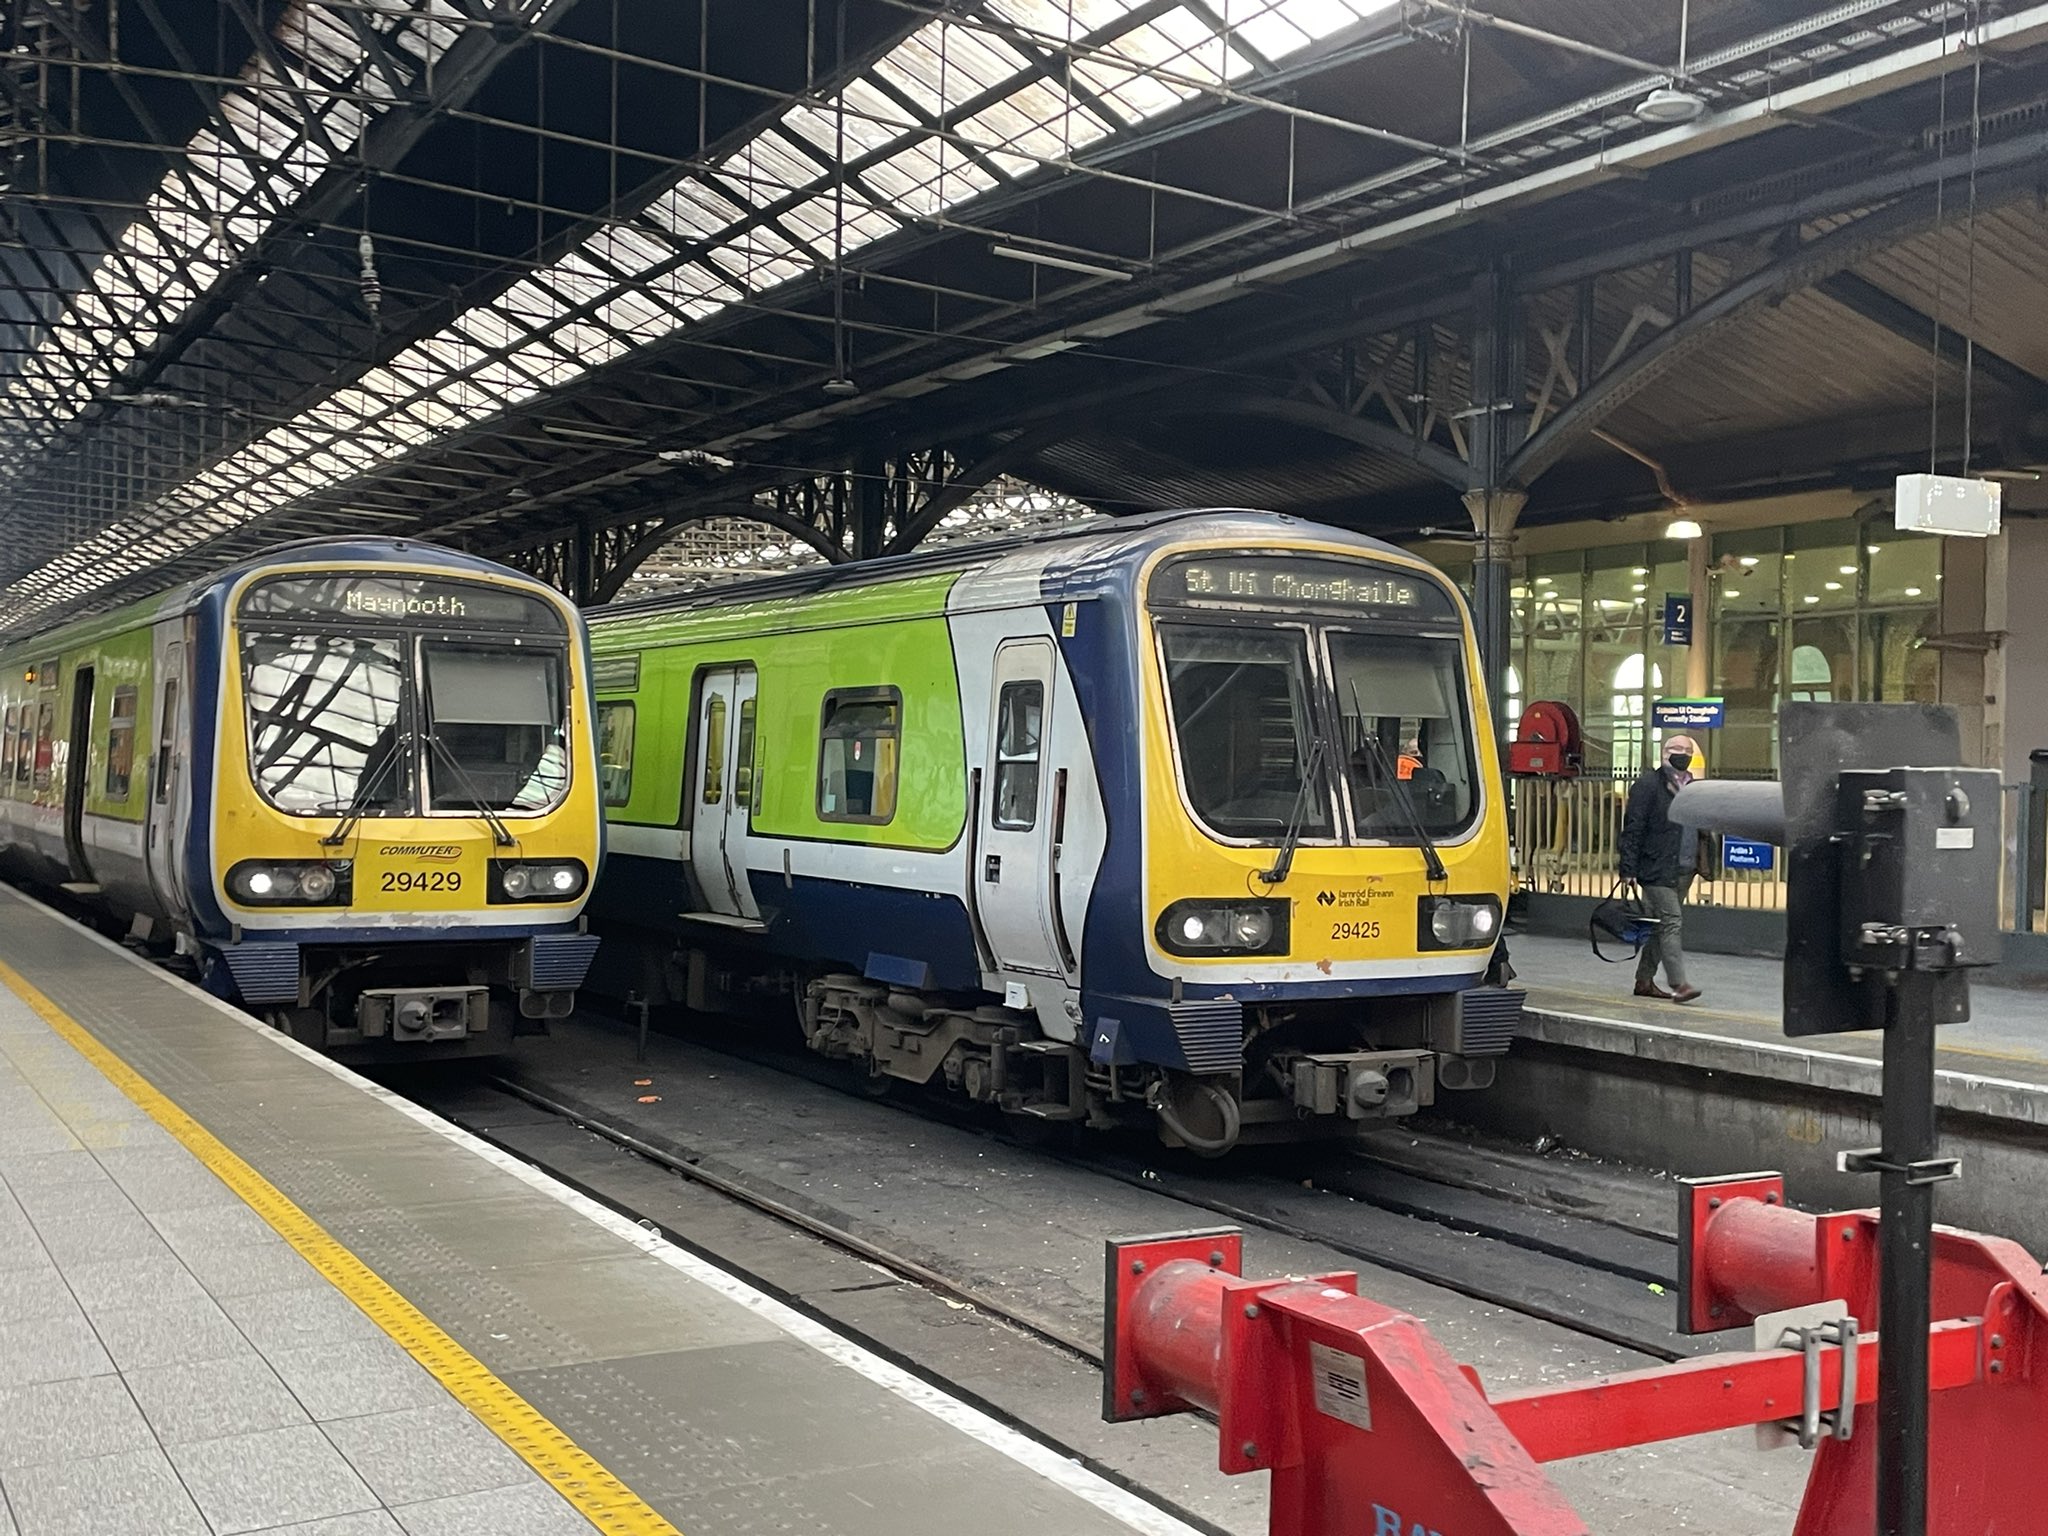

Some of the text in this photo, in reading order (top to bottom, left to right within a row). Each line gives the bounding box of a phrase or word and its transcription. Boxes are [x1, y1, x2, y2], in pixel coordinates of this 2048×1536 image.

[1185, 568, 1214, 593] St
[1273, 574, 1410, 605] Chonghaile
[346, 590, 466, 616] Maynooth
[1676, 605, 1686, 623] 2
[380, 845, 453, 856] COMMUTER
[381, 871, 462, 892] 29429
[1331, 921, 1381, 940] 29425
